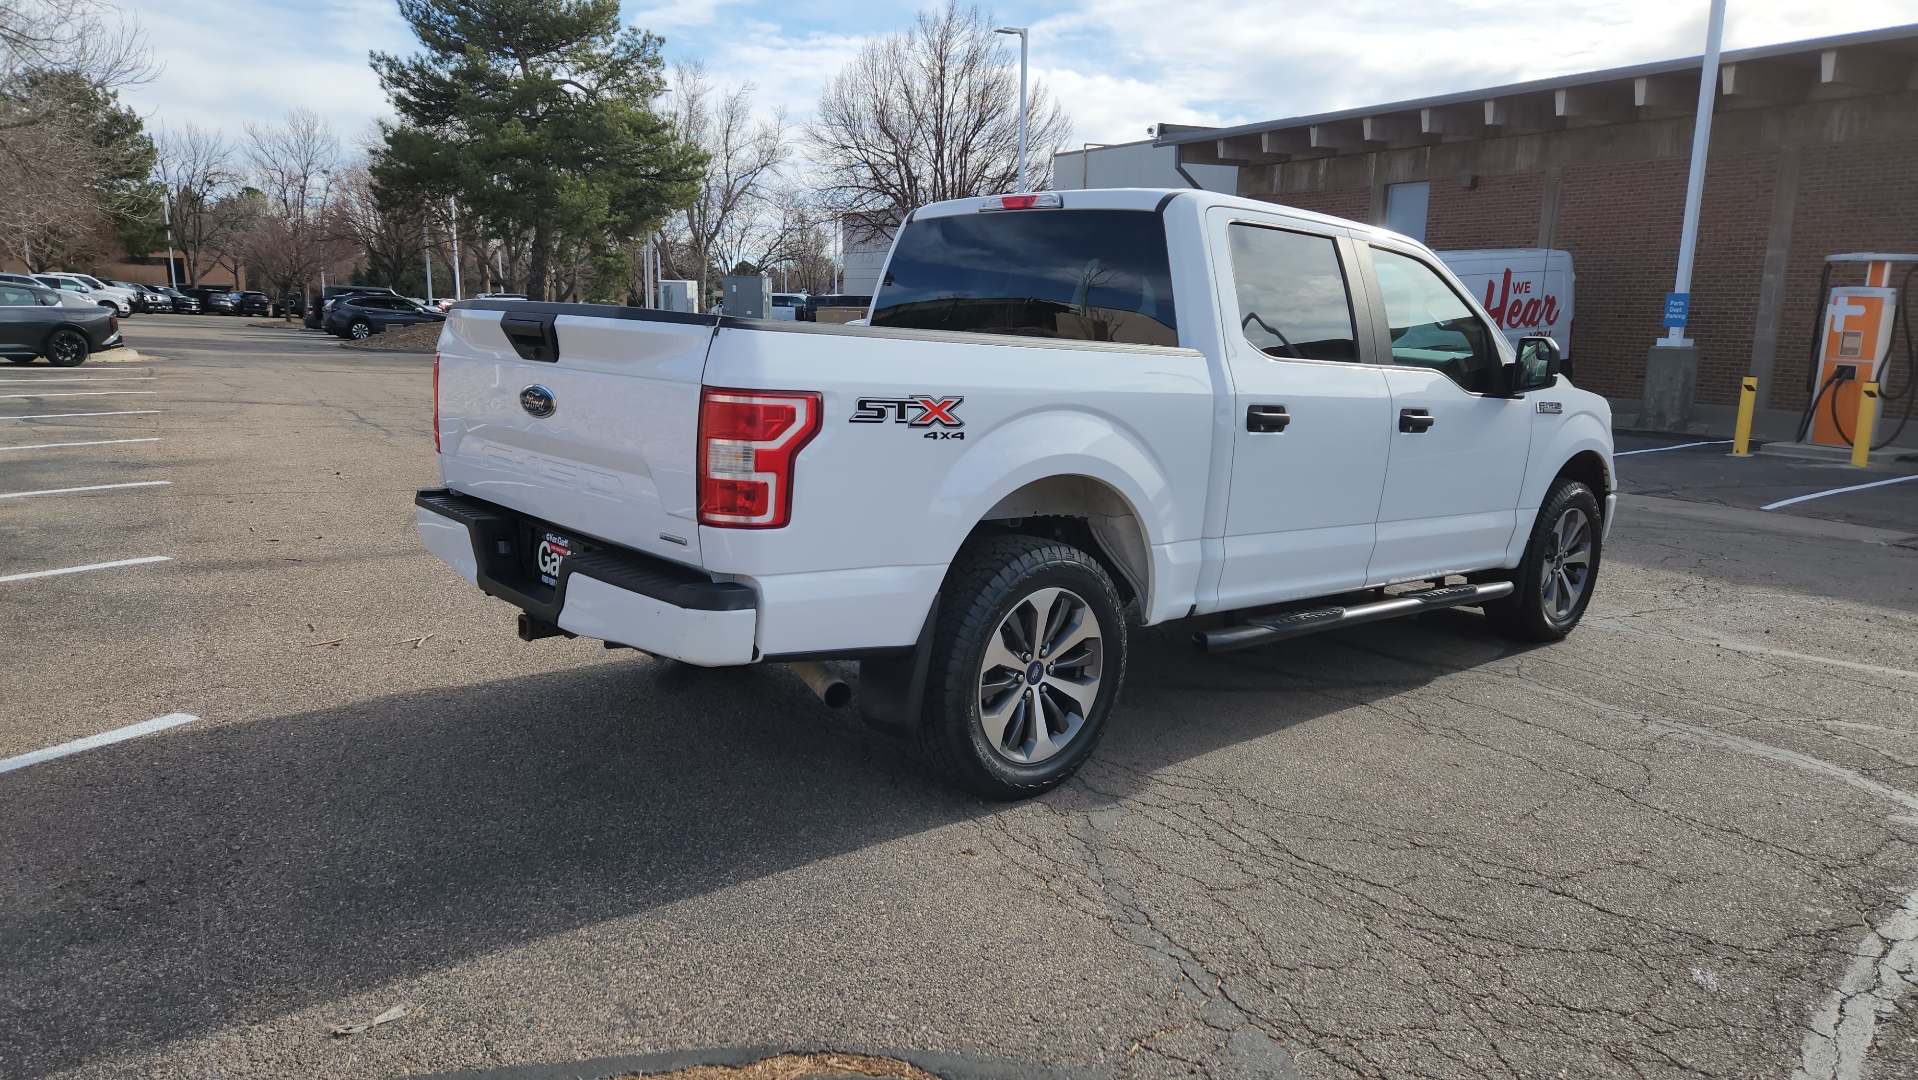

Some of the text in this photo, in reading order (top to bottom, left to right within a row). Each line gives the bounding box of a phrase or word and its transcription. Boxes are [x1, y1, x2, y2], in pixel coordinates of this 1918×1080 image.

[1513, 281, 1531, 294] WE
[1484, 267, 1560, 331] Hear
[525, 390, 546, 411] Ford
[849, 394, 965, 429] STX
[923, 431, 965, 441] 4x4
